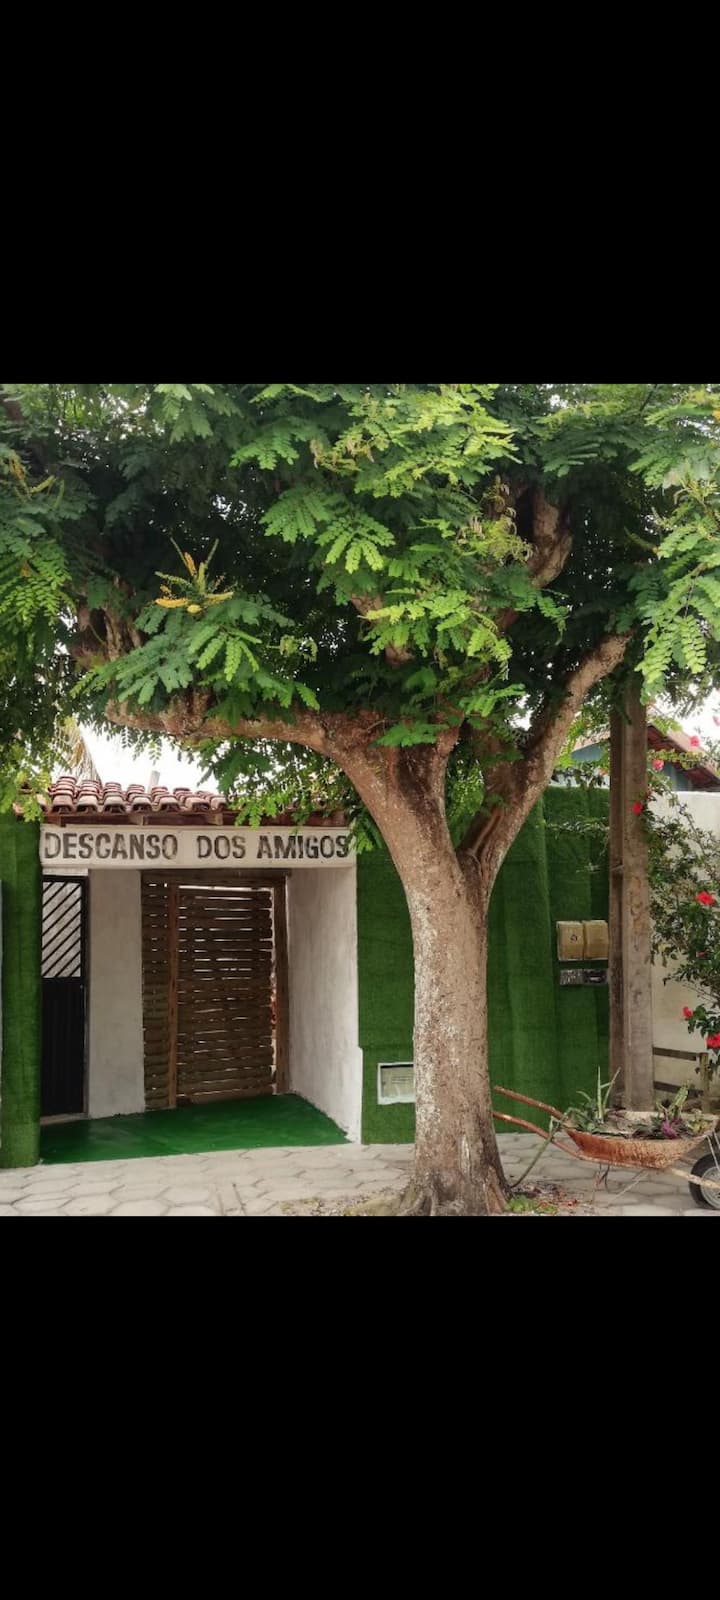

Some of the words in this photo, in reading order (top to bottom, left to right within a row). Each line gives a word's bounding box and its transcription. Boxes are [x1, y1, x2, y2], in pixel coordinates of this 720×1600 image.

[44, 832, 178, 860] DESCANSO
[196, 835, 246, 859] DOS
[256, 835, 349, 859] AMIGOS
